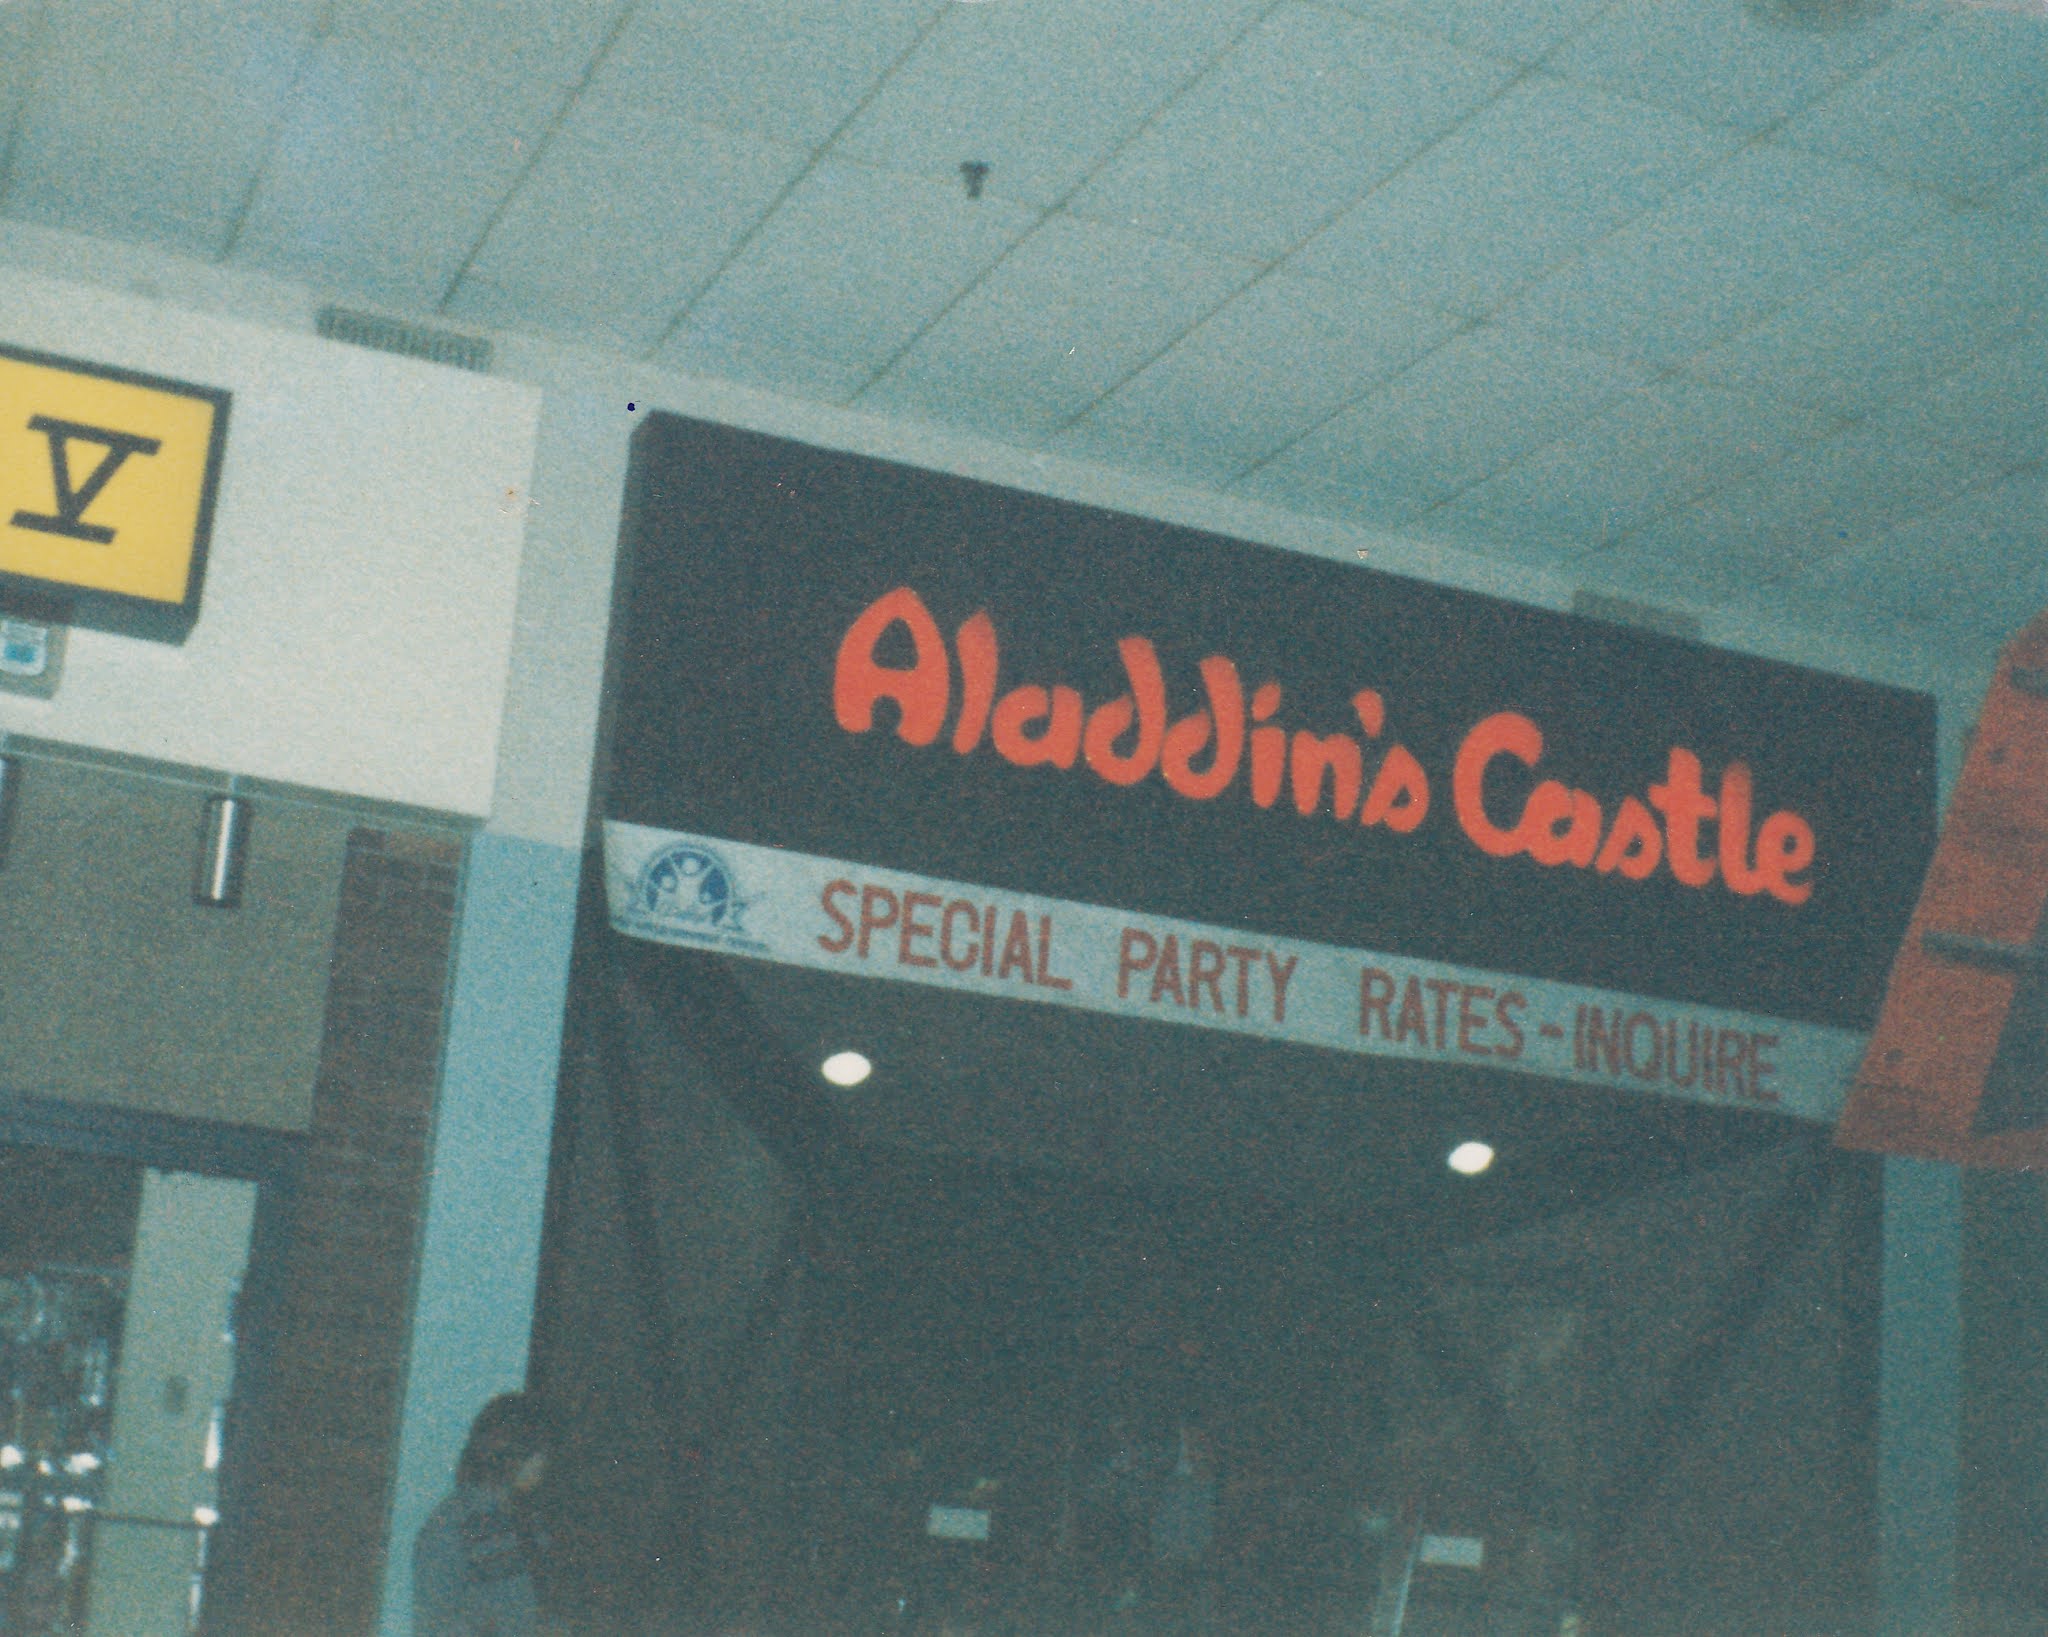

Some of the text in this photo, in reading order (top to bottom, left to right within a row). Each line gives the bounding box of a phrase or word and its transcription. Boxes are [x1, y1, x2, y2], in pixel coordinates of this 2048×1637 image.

[11, 414, 162, 545] V
[833, 587, 1815, 904] Aladdin's Castle
[818, 878, 1074, 991] SPECIAL
[1116, 927, 1299, 1023] PARTY
